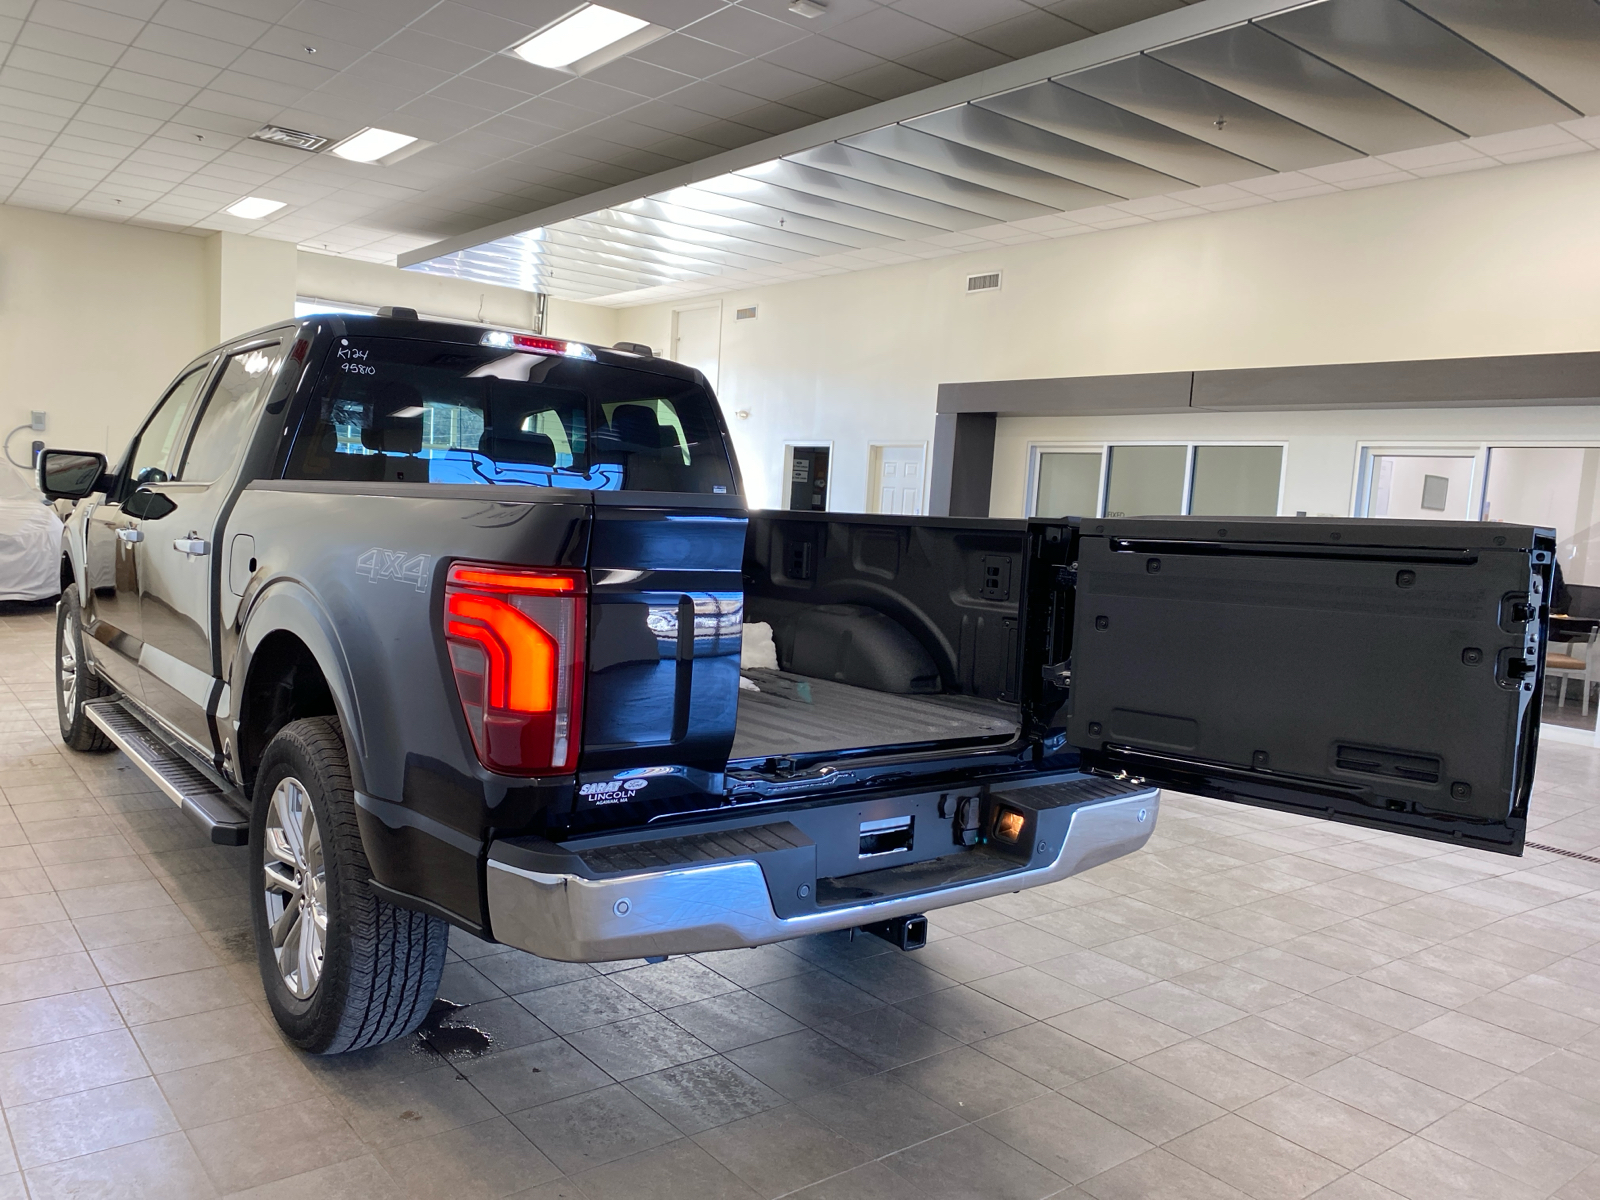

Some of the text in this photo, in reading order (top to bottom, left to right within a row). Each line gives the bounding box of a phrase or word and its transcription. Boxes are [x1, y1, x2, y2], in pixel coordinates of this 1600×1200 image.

[341, 363, 375, 375] 95810
[579, 781, 623, 795] SARAT
[588, 790, 636, 801] LINCOLN
